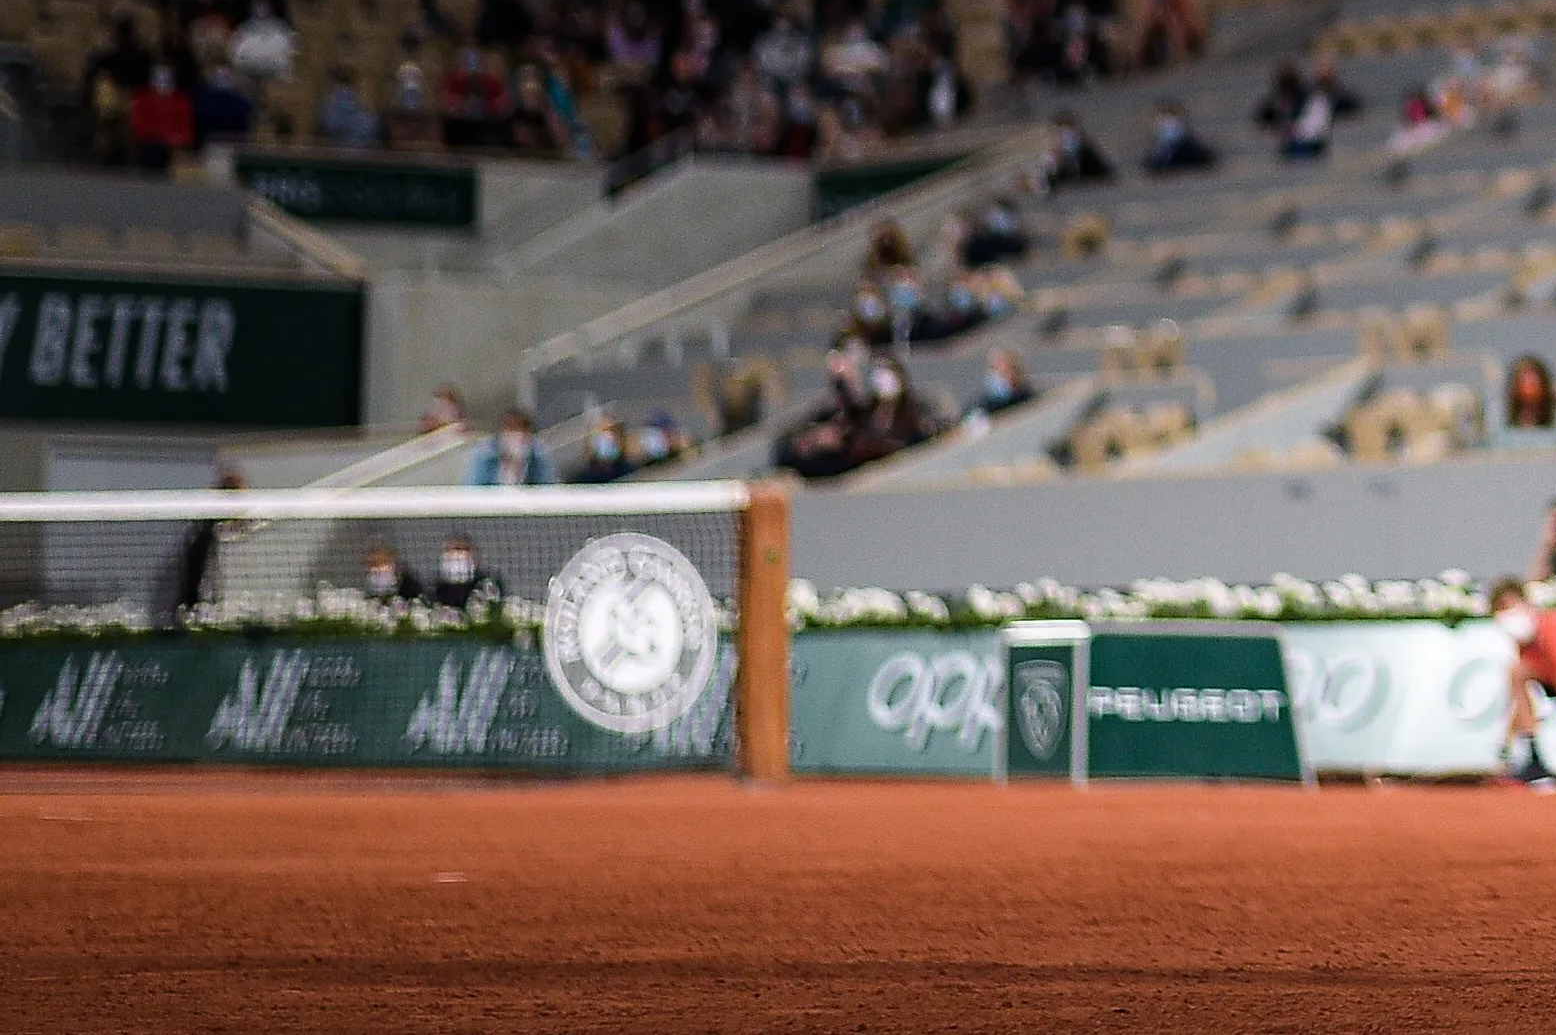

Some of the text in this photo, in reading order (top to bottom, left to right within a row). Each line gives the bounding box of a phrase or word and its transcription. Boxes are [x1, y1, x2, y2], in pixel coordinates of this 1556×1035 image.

[29, 291, 236, 393] BETTER
[867, 652, 1006, 754] opp
[1090, 686, 1286, 722] PEUGEOT
